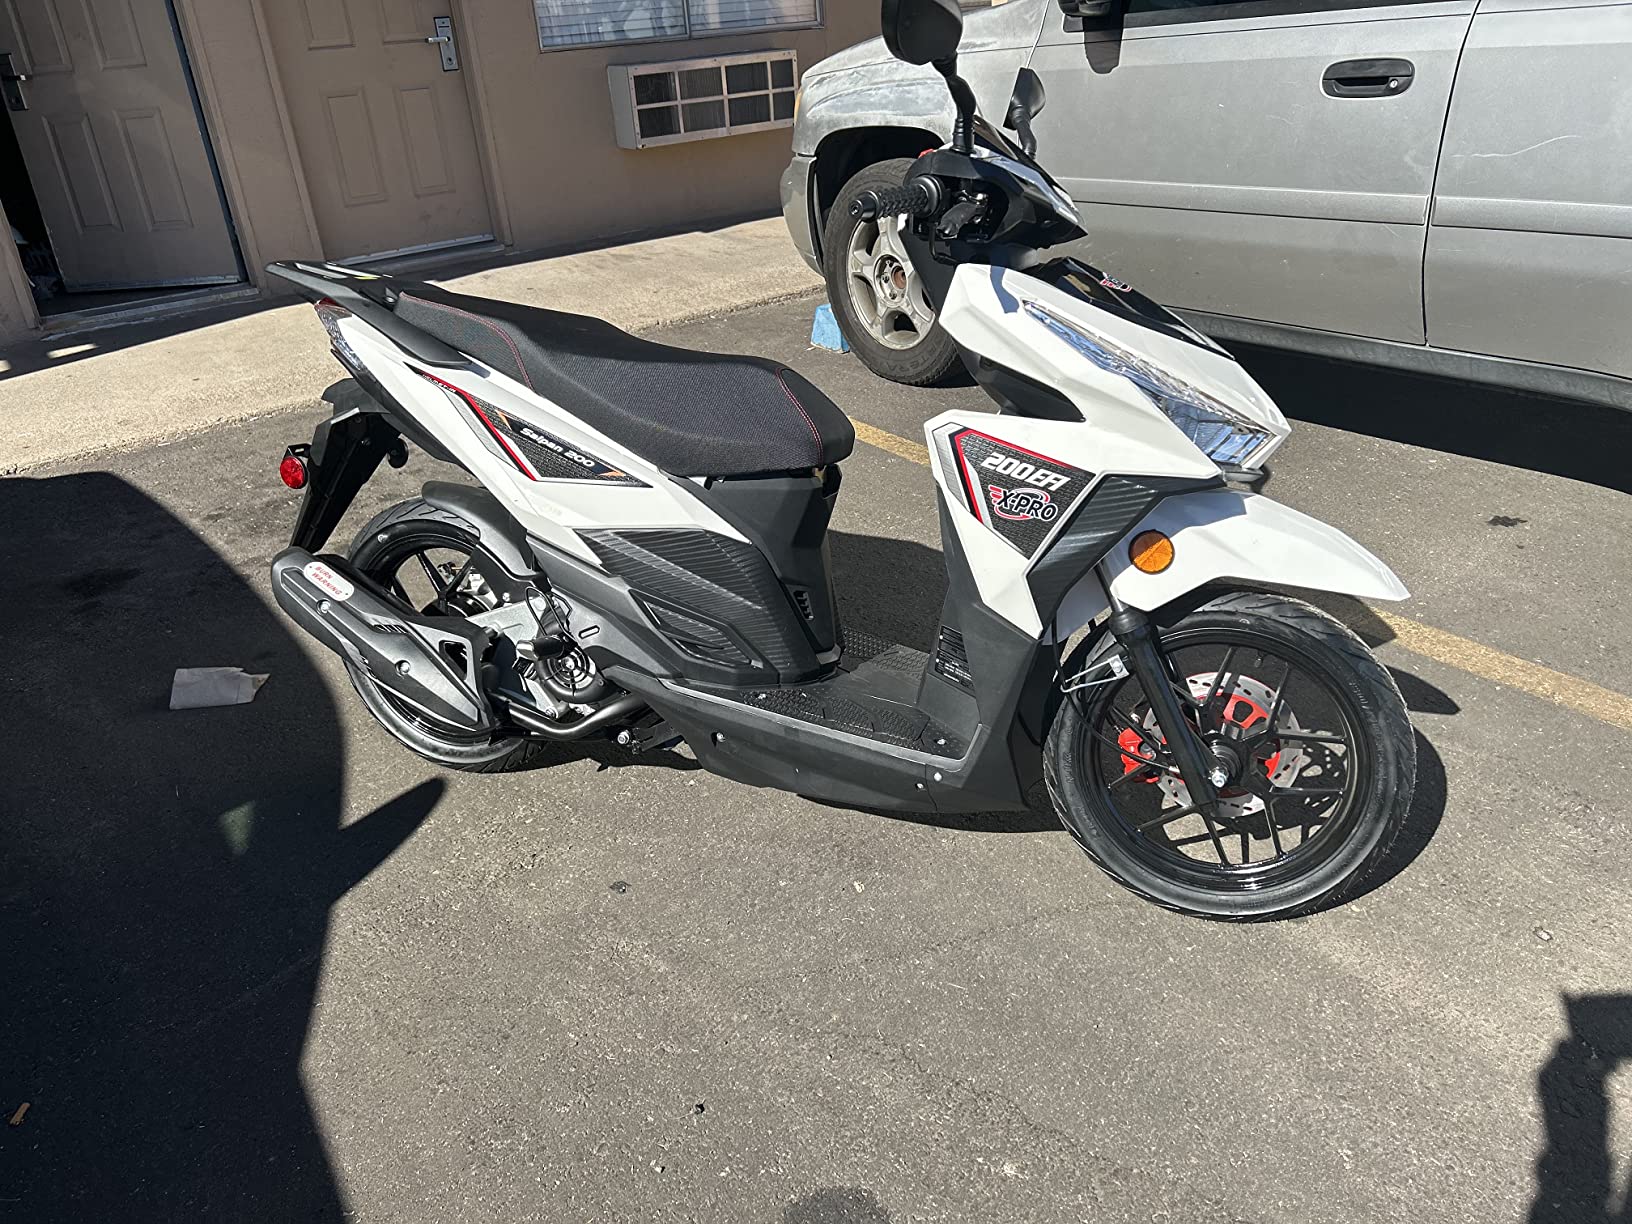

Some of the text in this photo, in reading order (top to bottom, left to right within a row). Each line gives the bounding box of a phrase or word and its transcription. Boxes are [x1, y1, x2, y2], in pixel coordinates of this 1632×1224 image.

[564, 450, 596, 467] 200
[996, 489, 1058, 521] X-PRO
[314, 566, 333, 579] BURN
[312, 572, 342, 595] WARNING
